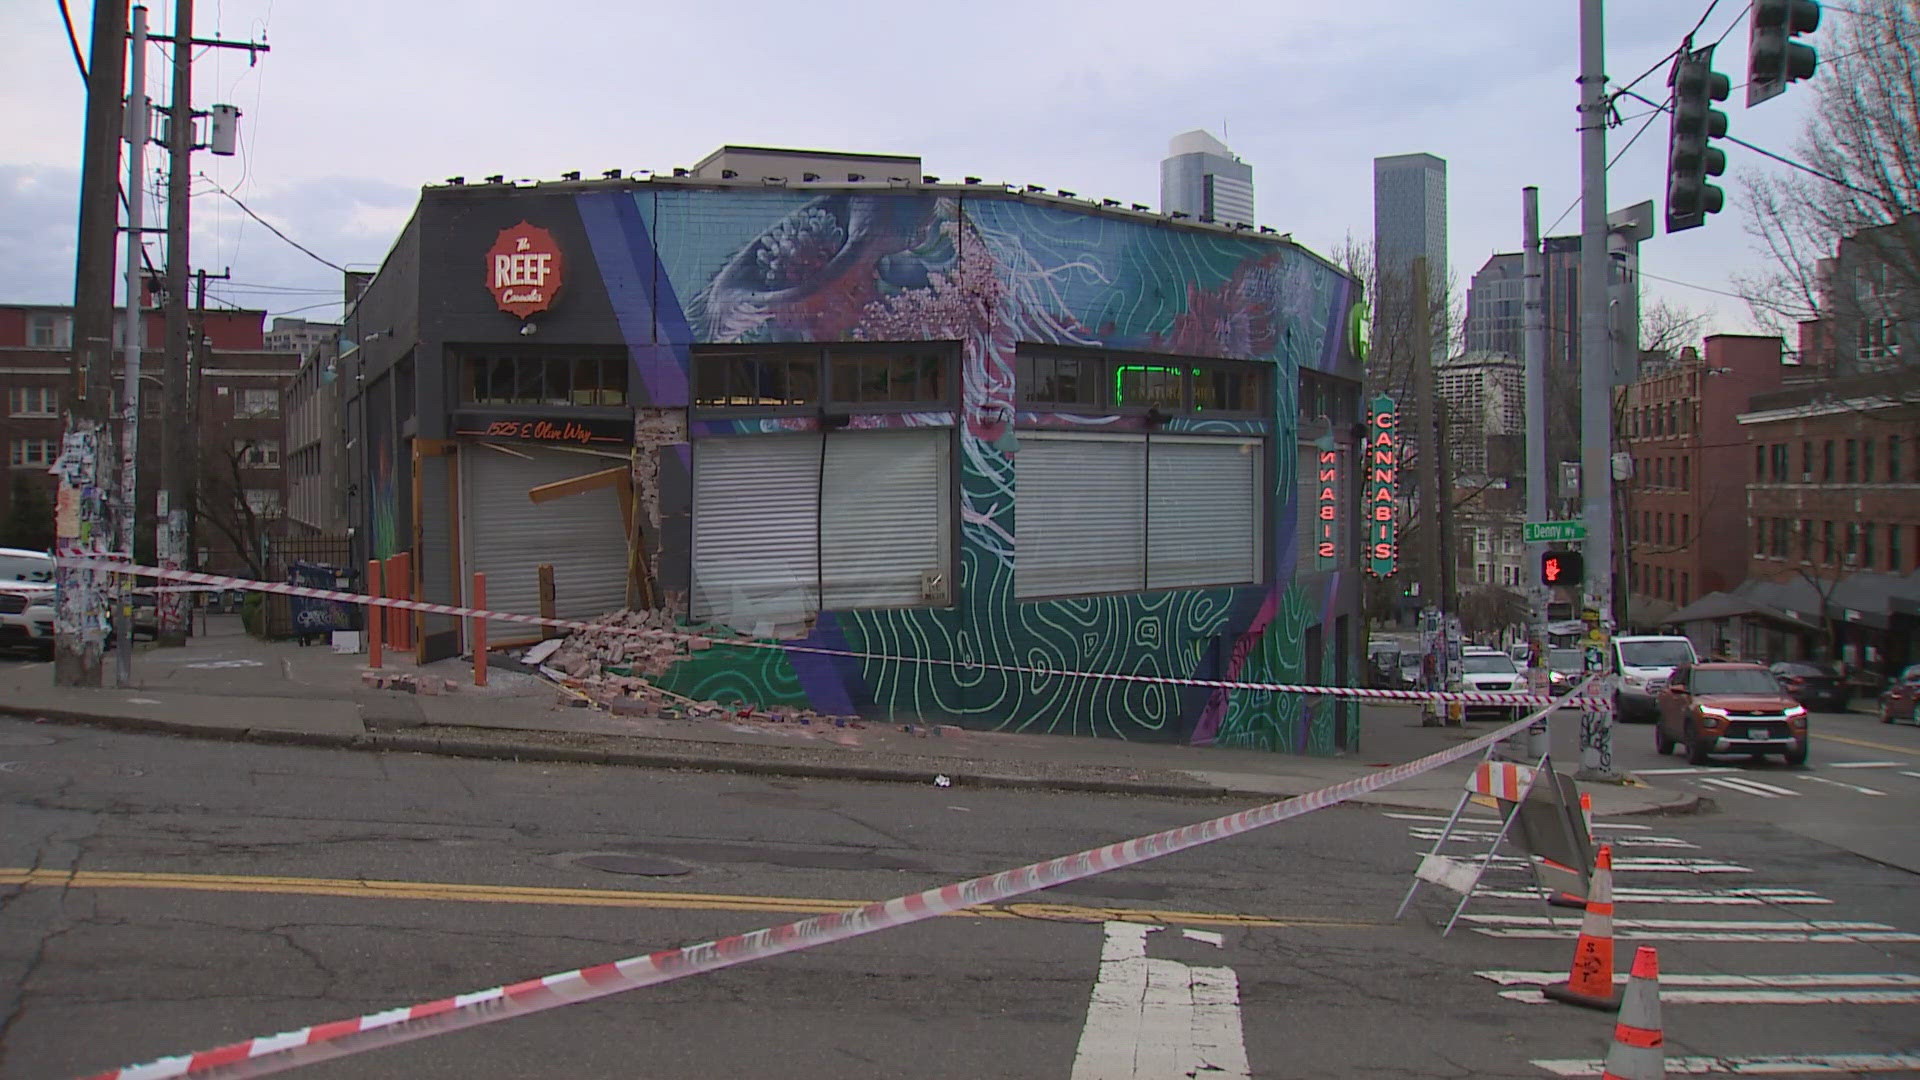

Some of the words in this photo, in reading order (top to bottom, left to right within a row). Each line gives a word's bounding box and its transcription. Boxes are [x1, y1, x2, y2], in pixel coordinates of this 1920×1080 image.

[495, 253, 552, 288] REEF
[485, 421, 521, 436] 1525
[520, 423, 533, 438] E
[533, 421, 562, 440] Olive
[562, 422, 592, 444] Way
[1375, 412, 1393, 560] CANNABIS
[1525, 528, 1532, 539] E
[1534, 524, 1561, 540] Denny
